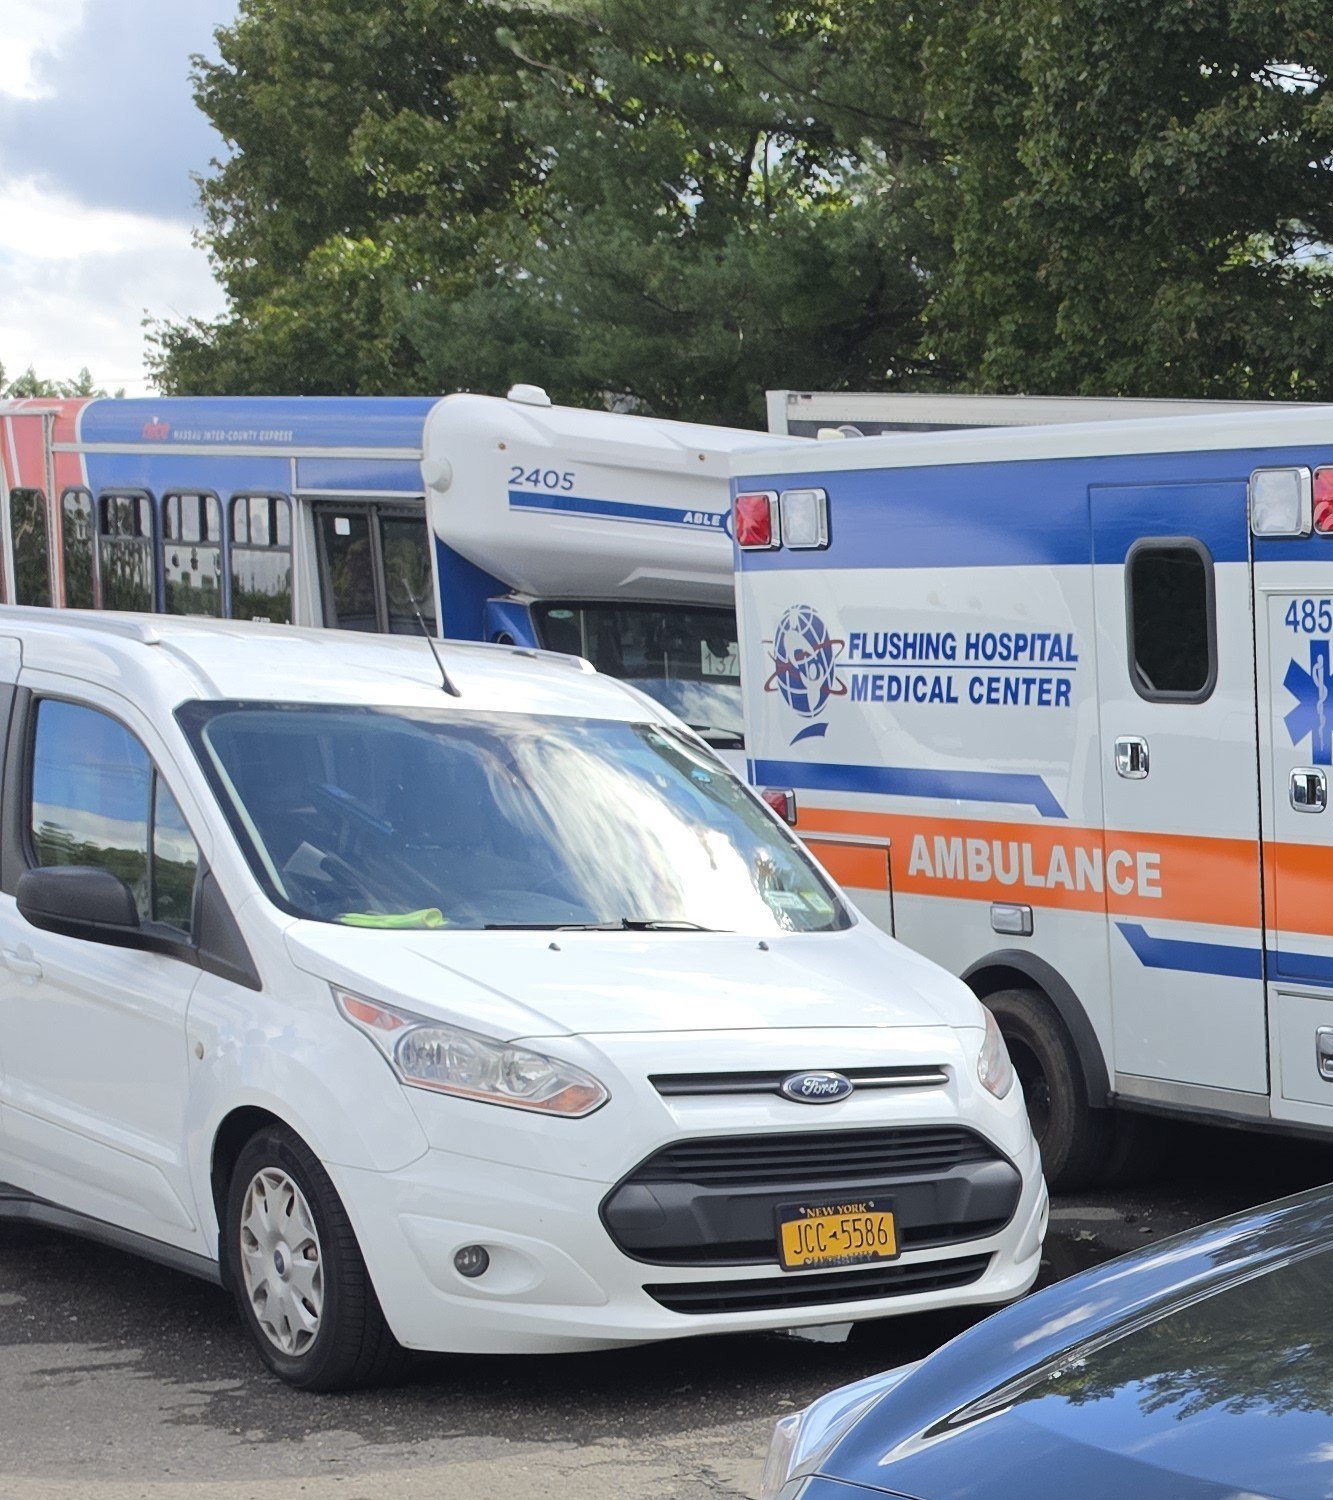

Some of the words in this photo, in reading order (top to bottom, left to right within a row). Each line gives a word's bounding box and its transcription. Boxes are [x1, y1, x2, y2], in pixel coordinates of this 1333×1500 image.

[508, 466, 575, 491] 2405
[683, 511, 722, 527] ABLE
[848, 632, 957, 661] FLUSHING
[964, 632, 1079, 662] HOSPITAL
[850, 674, 959, 704] MEDICAL
[968, 676, 1072, 707] CENTER
[908, 834, 1162, 898] AMBULANCE
[801, 1077, 840, 1096] Ford
[806, 1206, 835, 1218] NEW
[836, 1203, 867, 1214] YORK
